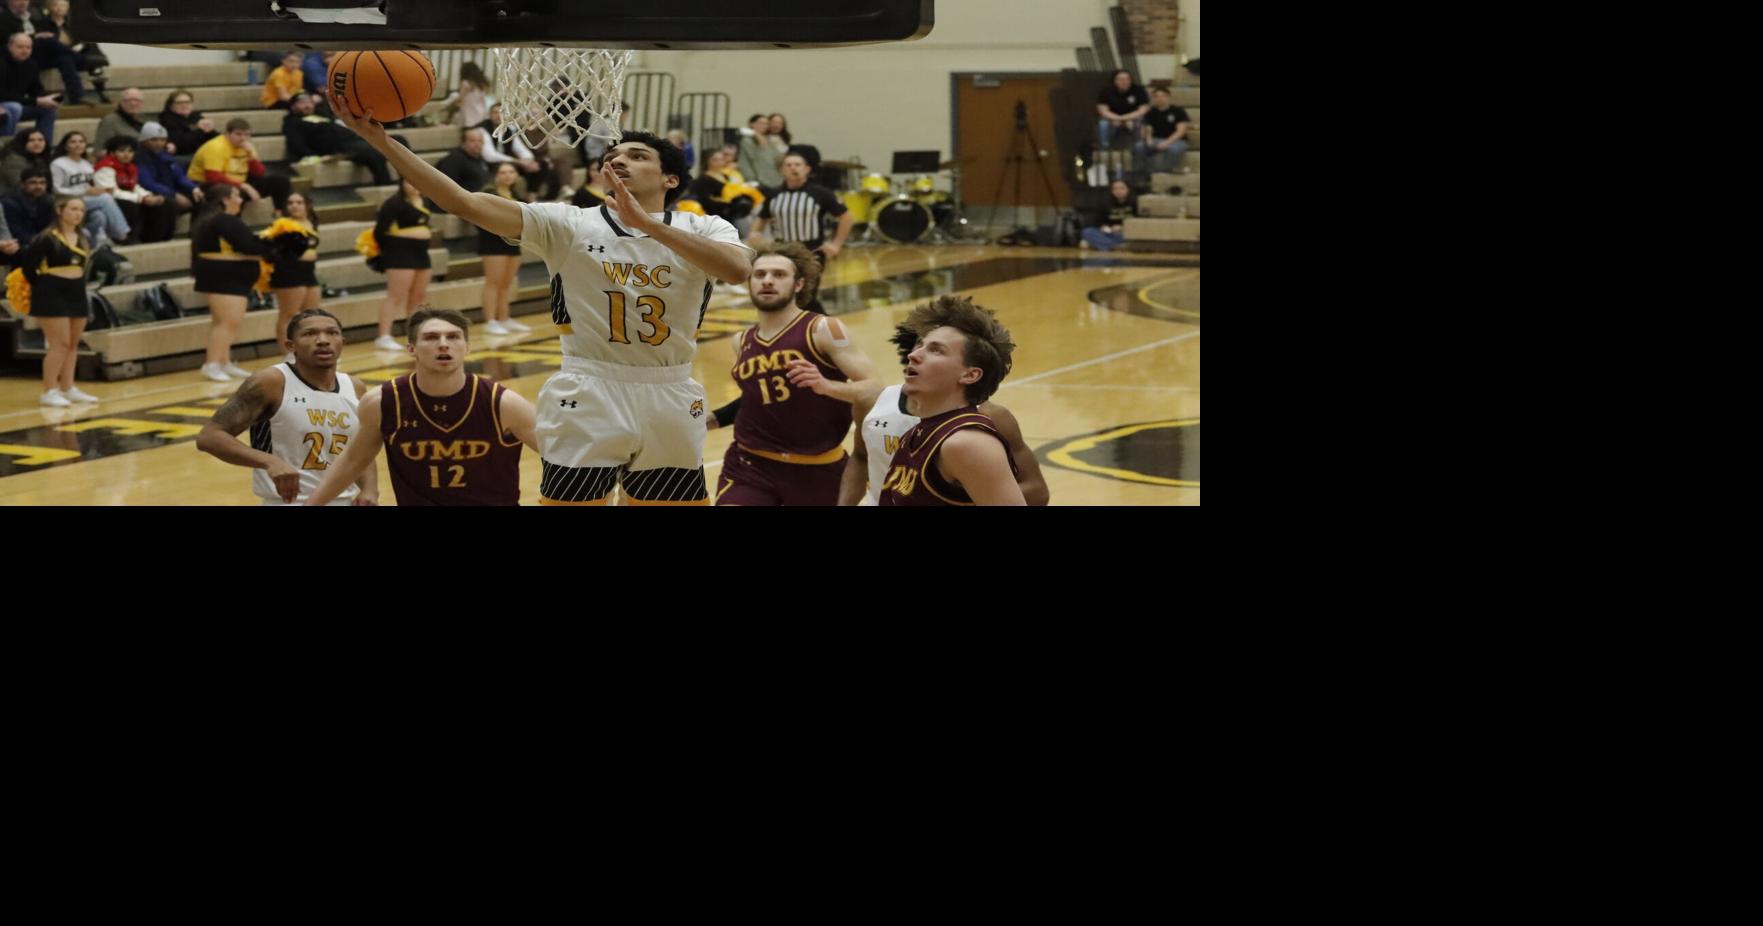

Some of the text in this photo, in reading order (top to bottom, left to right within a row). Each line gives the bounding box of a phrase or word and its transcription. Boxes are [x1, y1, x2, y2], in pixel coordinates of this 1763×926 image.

[602, 261, 672, 289] WSC
[603, 290, 671, 346] 13
[758, 376, 790, 405] 13
[306, 409, 351, 429] WSC
[301, 432, 348, 470] 25
[400, 440, 491, 460] UMD
[429, 465, 466, 488] 12
